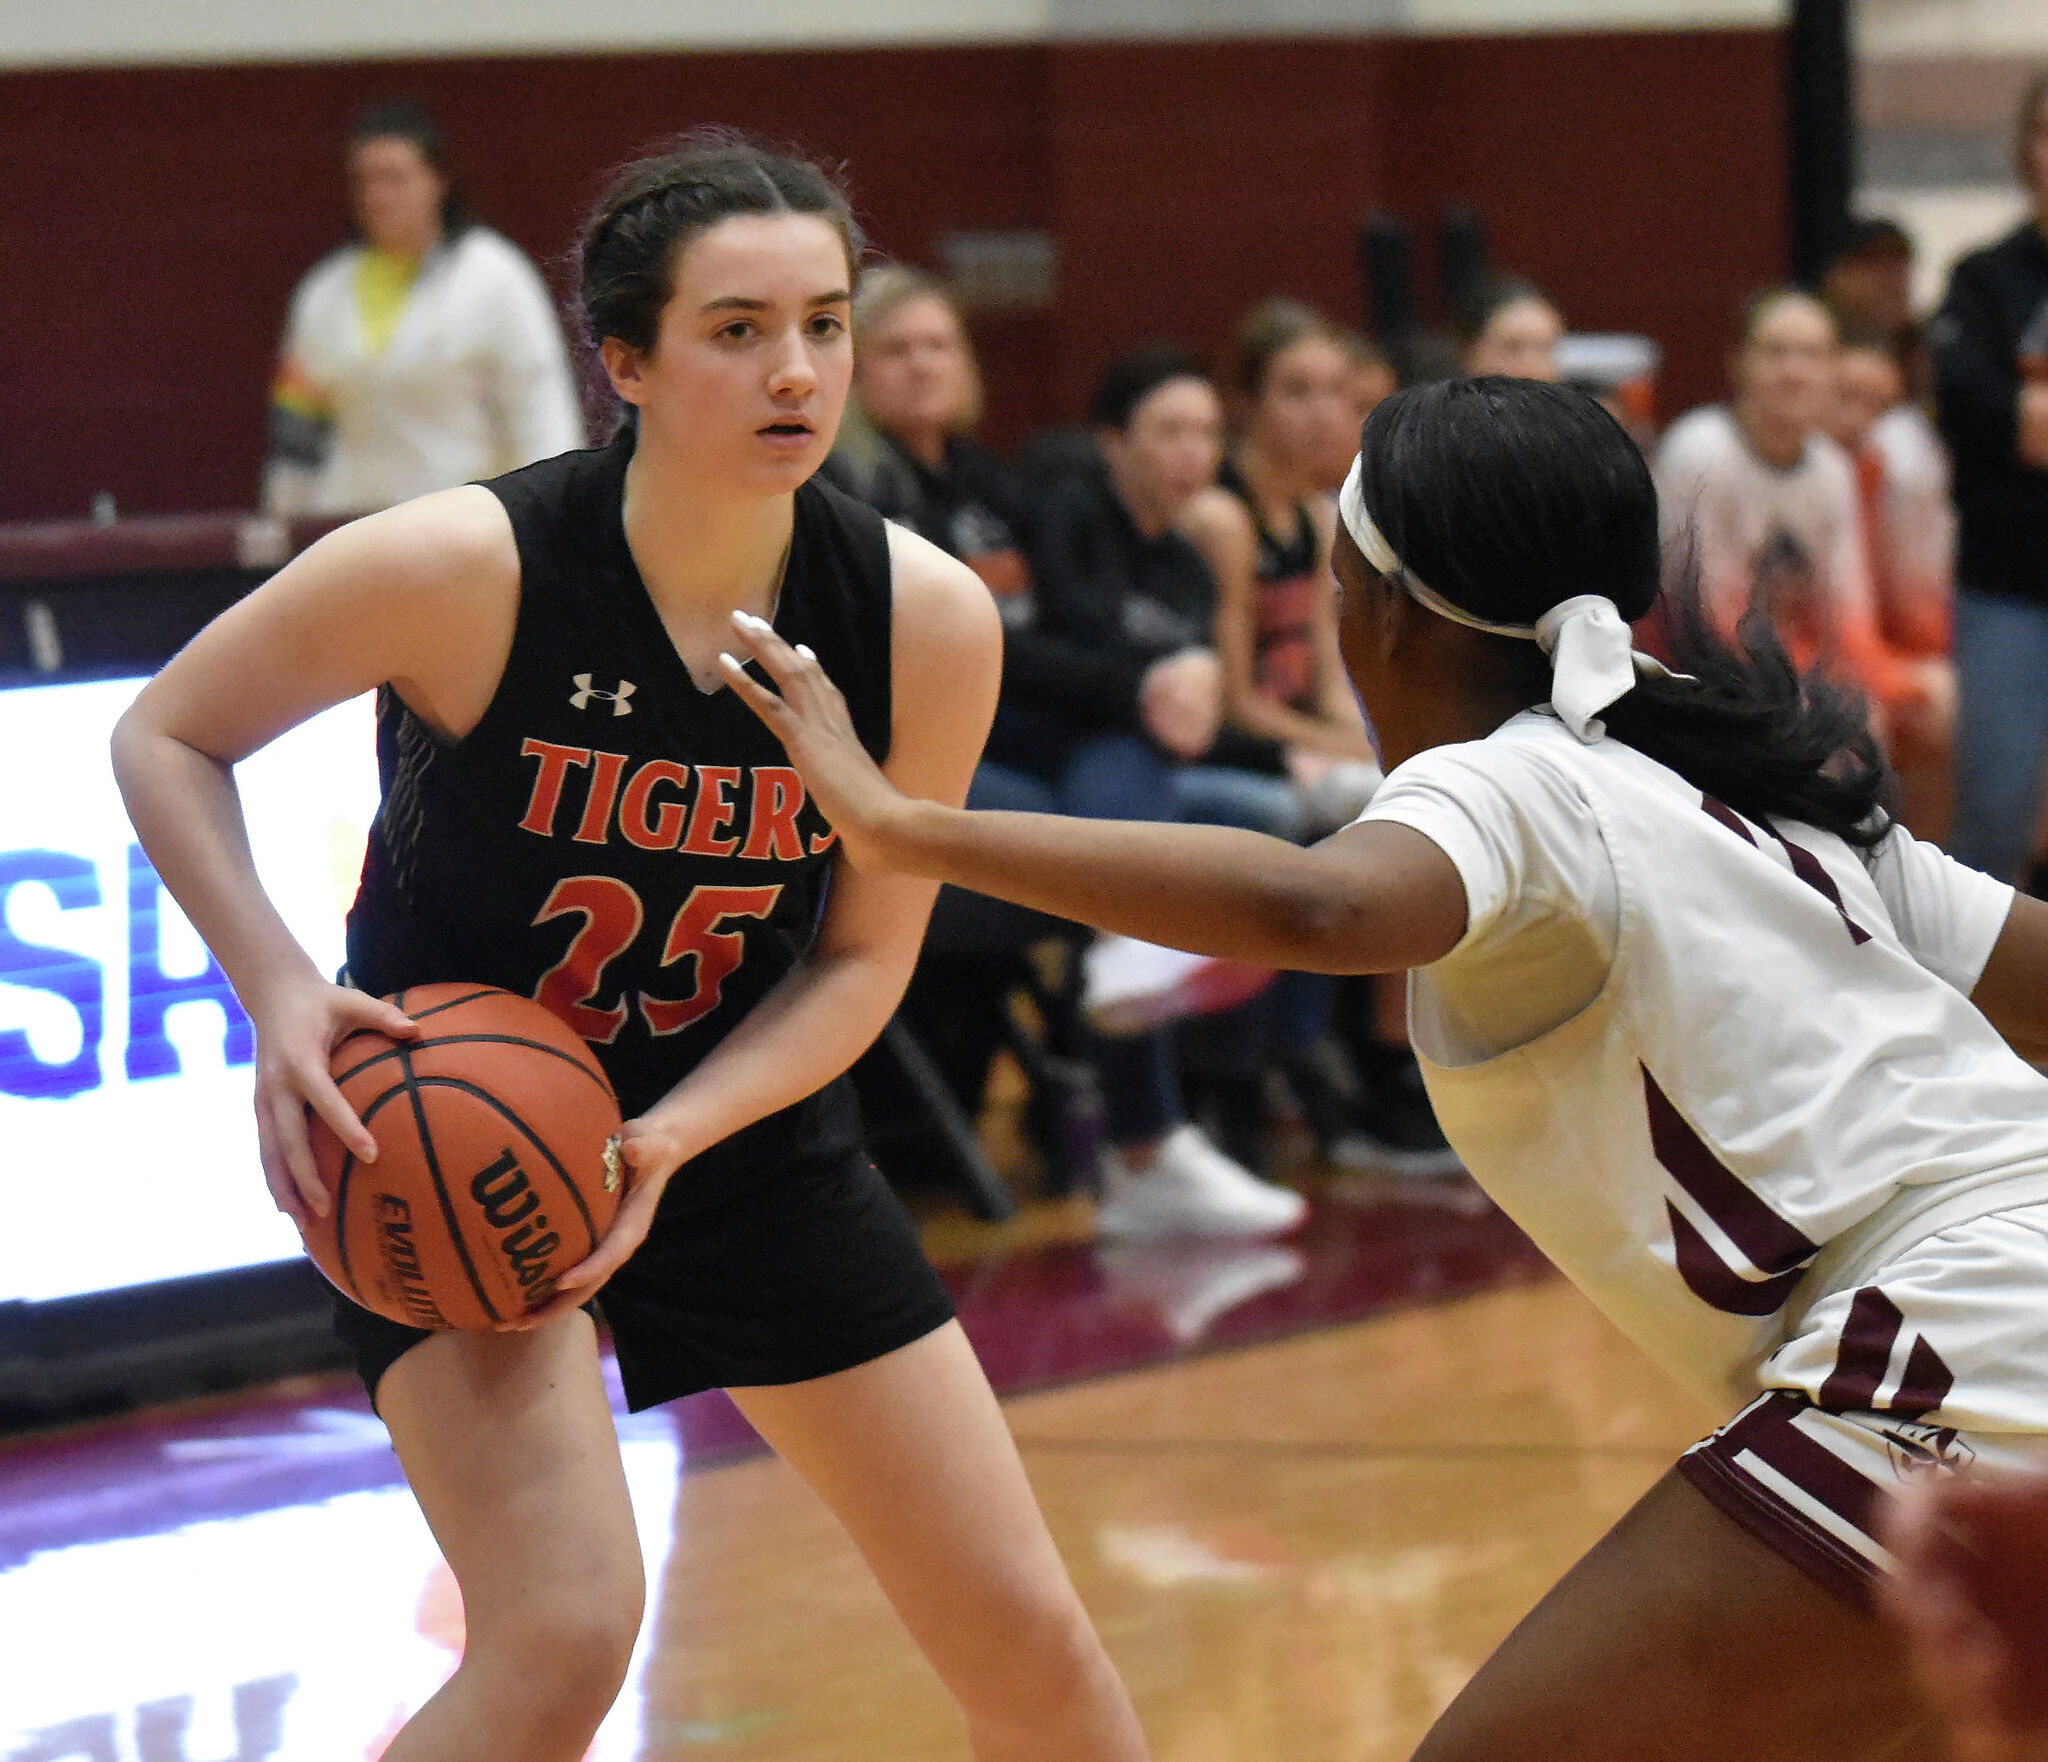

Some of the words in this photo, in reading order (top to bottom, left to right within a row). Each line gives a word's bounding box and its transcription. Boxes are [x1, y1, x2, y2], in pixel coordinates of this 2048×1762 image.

[517, 737, 838, 861] TIGER
[531, 875, 785, 1044] 25
[471, 1145, 560, 1306] Wilso
